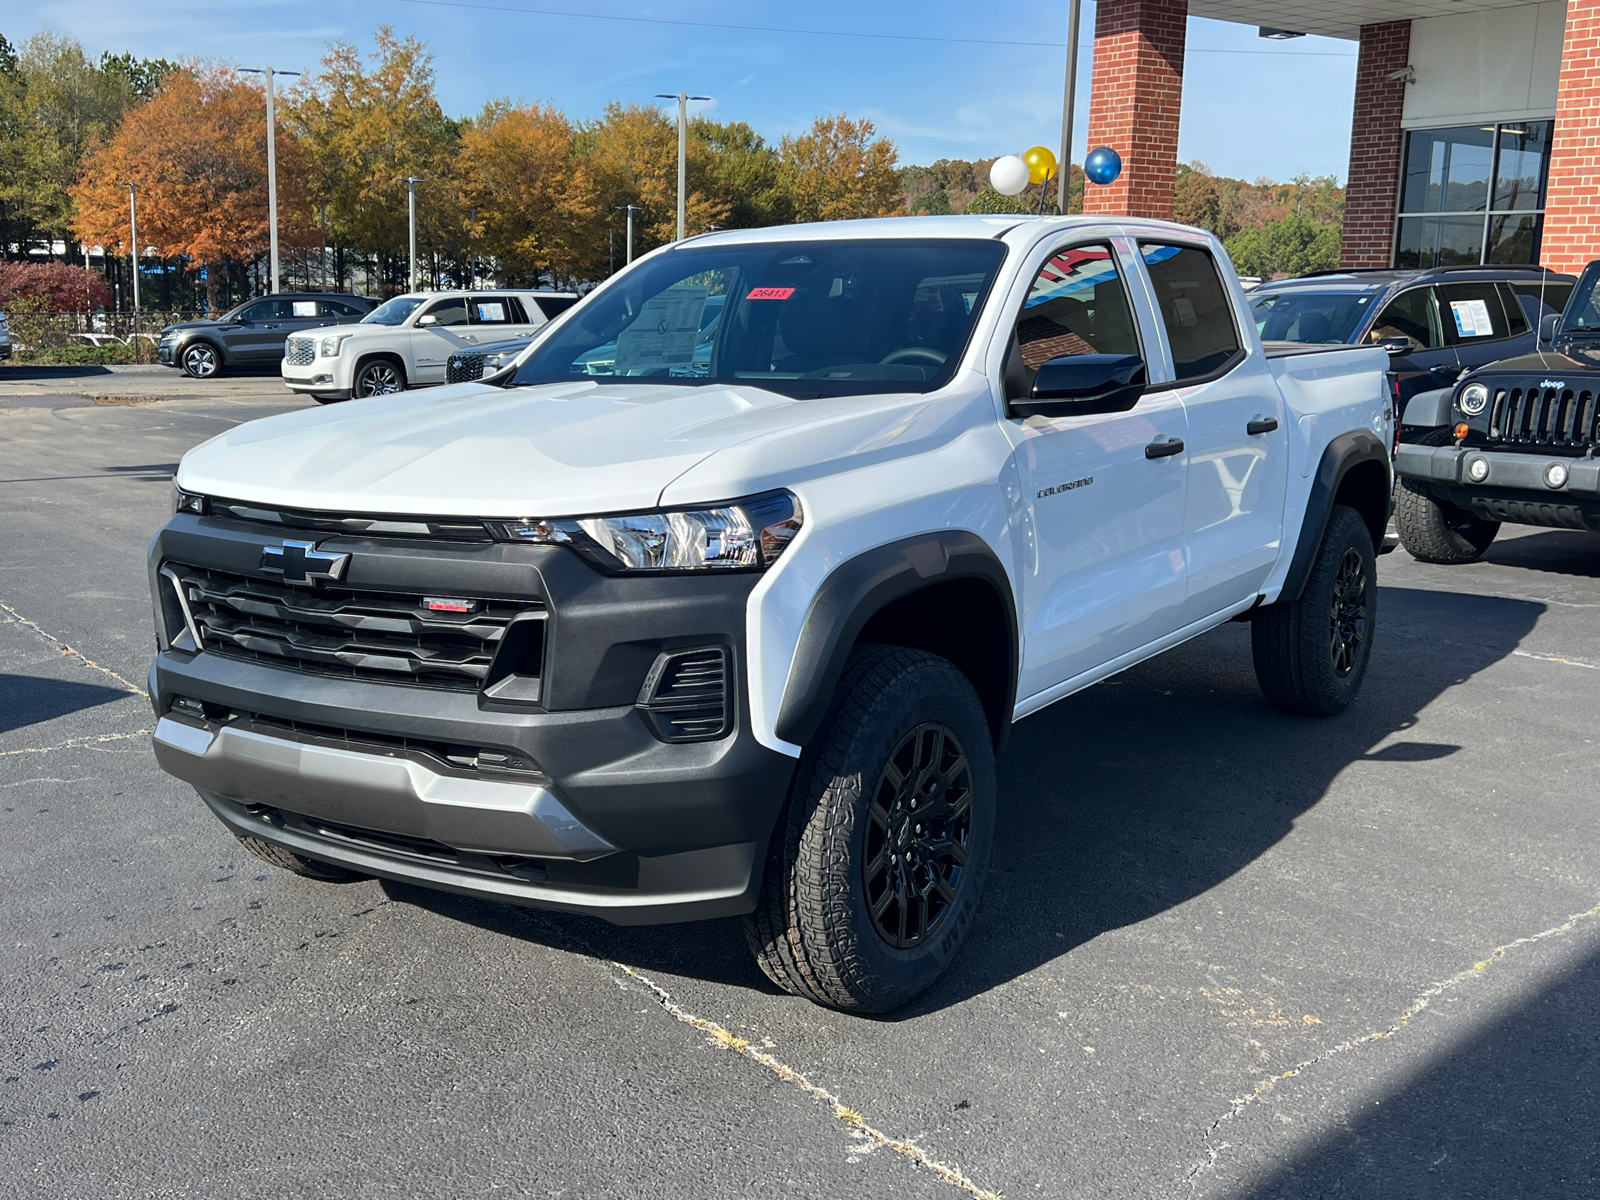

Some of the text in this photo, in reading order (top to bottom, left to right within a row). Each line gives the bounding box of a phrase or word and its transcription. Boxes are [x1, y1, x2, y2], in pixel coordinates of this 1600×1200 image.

[752, 289, 788, 298] 26413
[1540, 379, 1565, 390] Jeep
[1036, 476, 1093, 499] COLORADO
